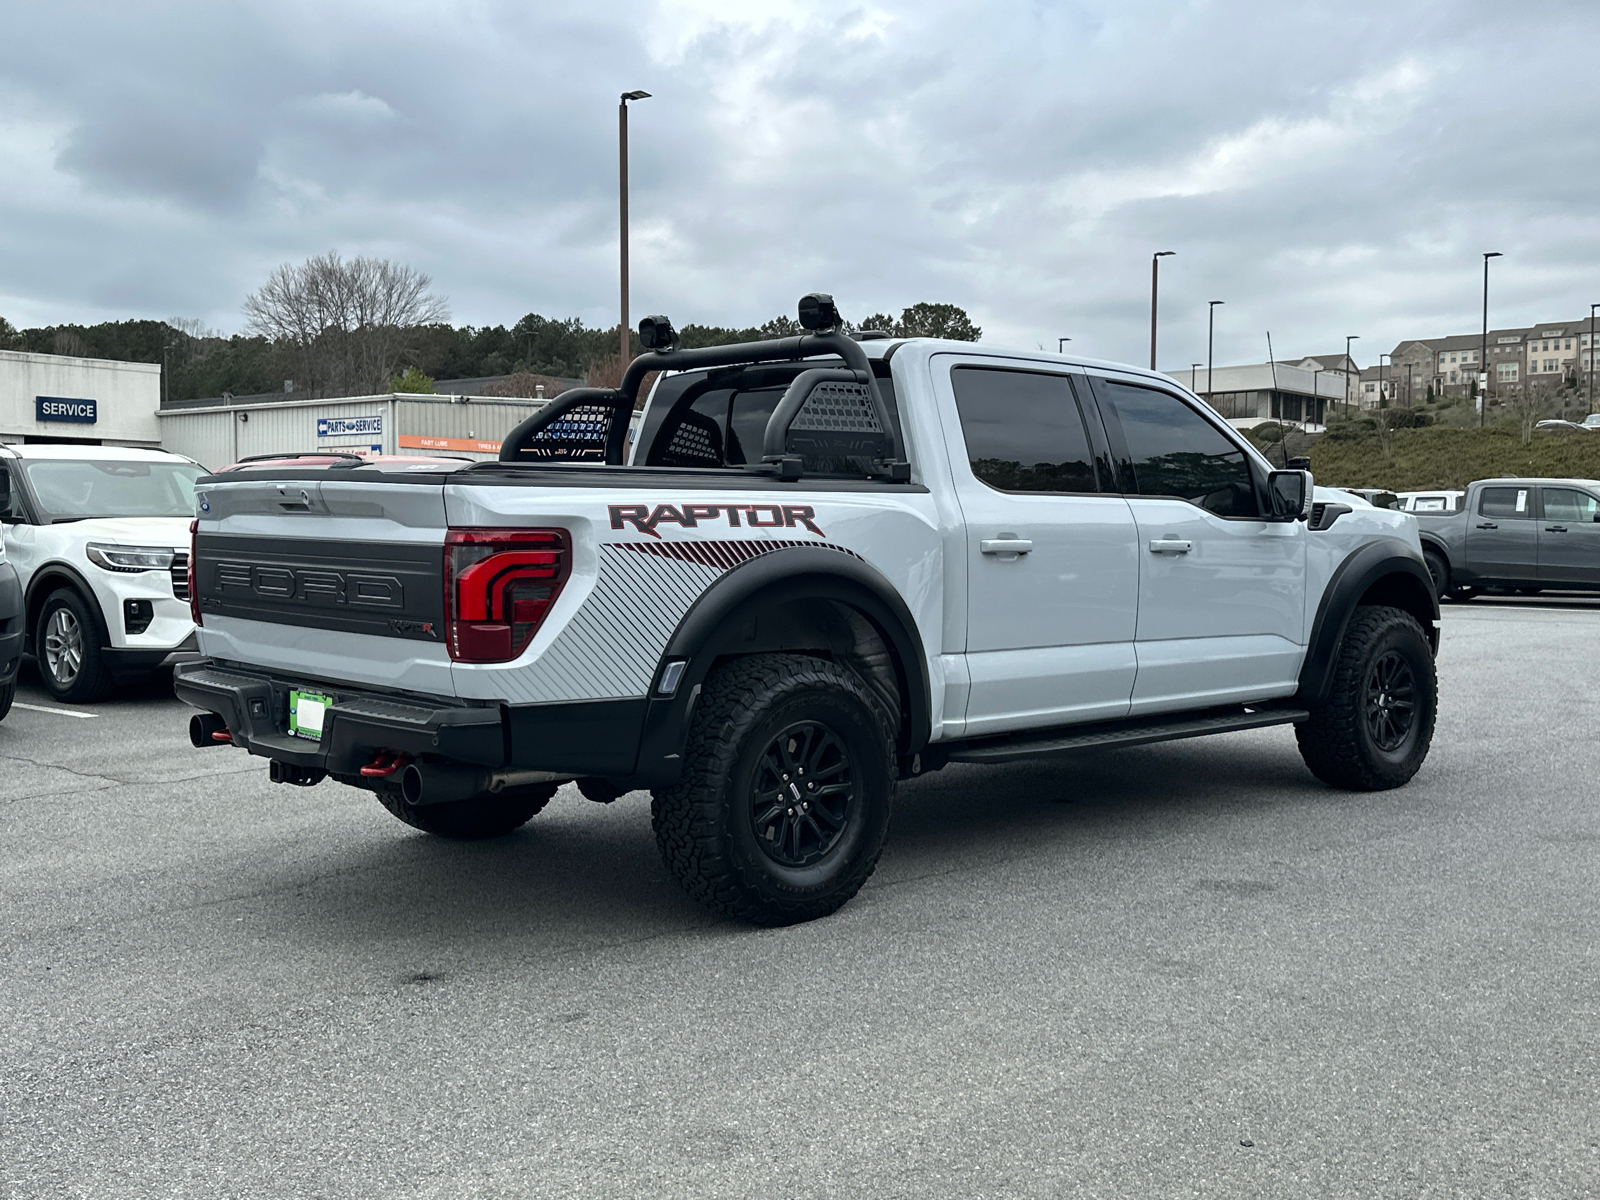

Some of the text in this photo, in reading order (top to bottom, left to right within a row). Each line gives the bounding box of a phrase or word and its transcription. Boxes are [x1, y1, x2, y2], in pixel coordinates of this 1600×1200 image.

[42, 402, 94, 417] SERVICE
[327, 419, 381, 433] PARTS SERVICE
[607, 504, 826, 539] RAPTOR
[215, 563, 404, 610] FORD
